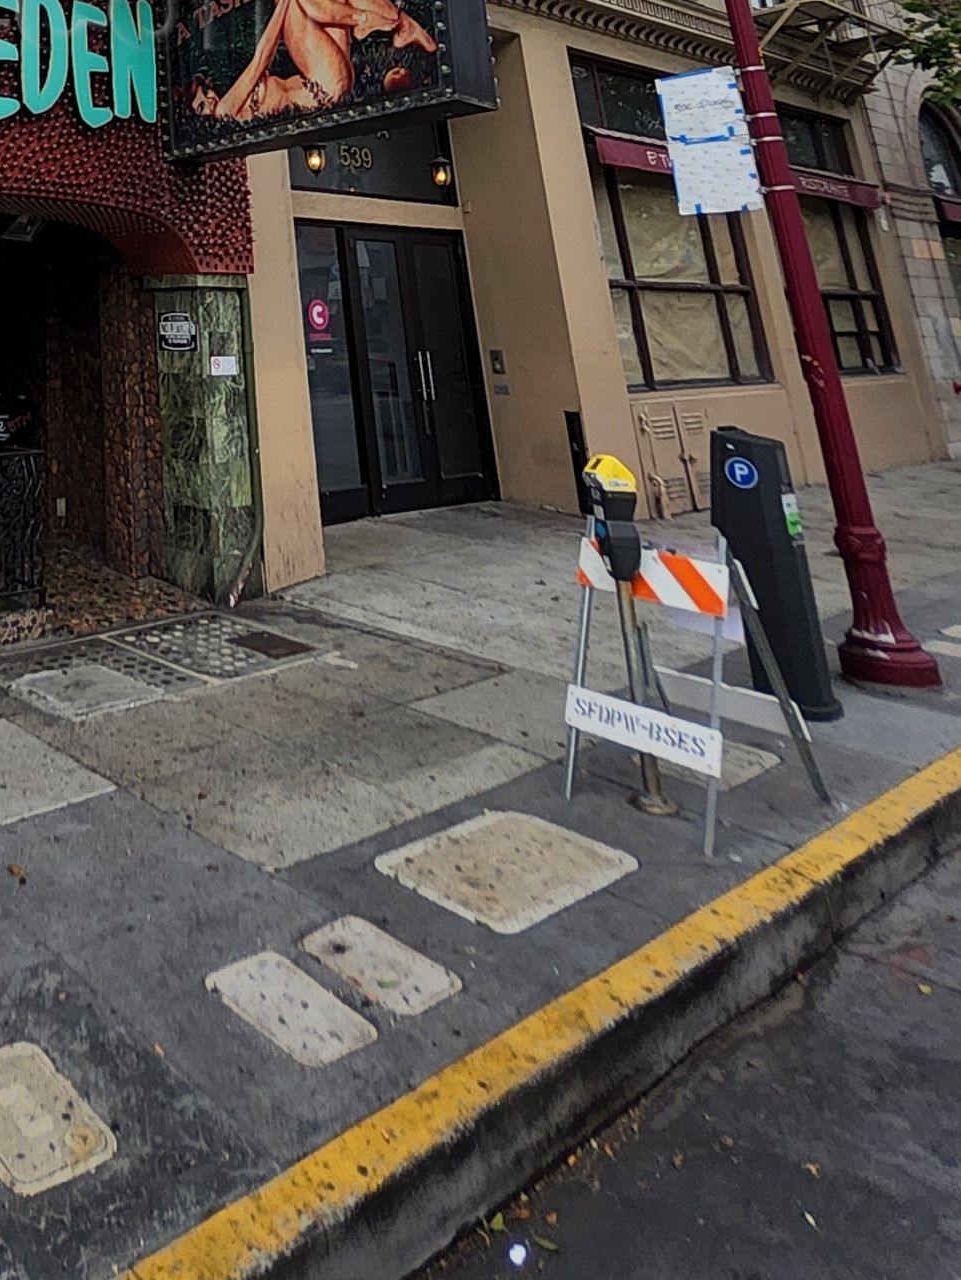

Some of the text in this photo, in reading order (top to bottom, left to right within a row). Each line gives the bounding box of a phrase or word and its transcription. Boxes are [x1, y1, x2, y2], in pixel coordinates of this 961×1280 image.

[175, 21, 191, 46] A
[340, 145, 373, 169] 539
[733, 462, 750, 483] P
